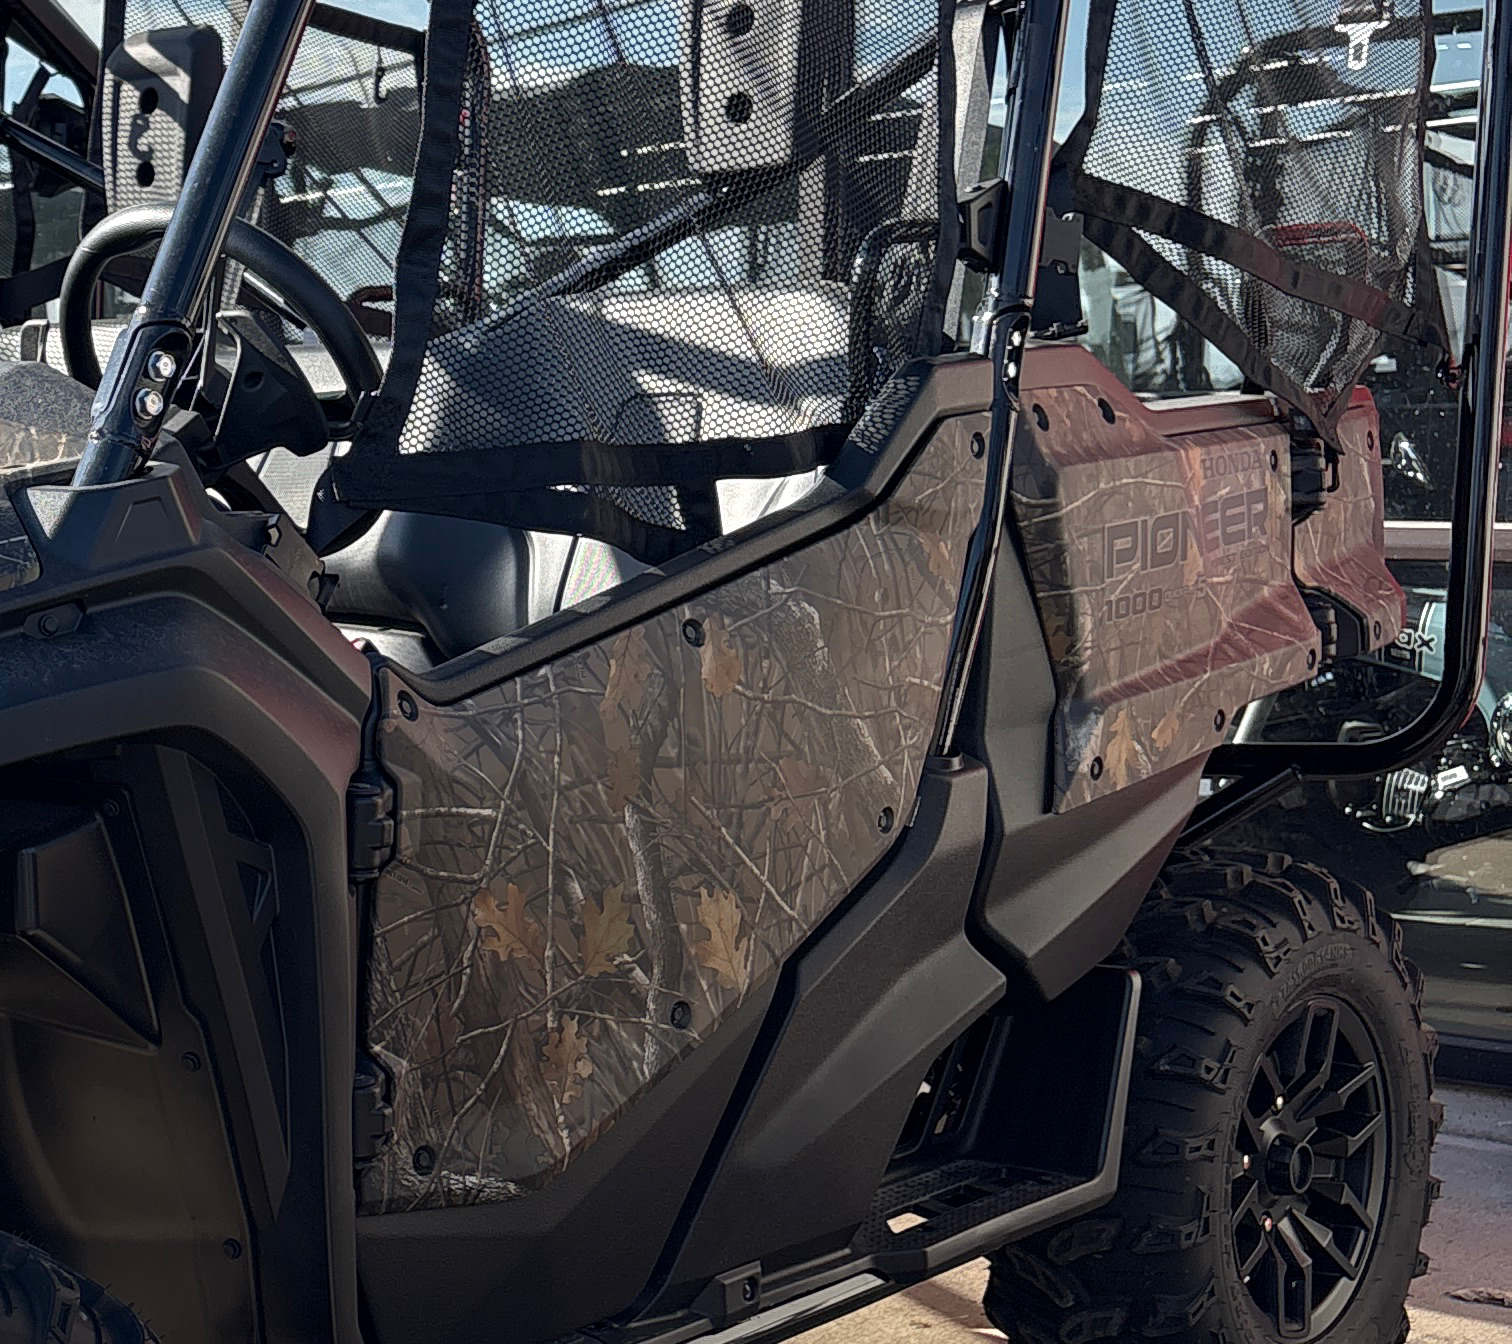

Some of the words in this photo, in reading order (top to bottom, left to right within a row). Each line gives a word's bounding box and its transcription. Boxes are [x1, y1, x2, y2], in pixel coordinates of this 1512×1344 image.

[1200, 450, 1264, 480] HONDA
[1103, 487, 1269, 583] PIONEER
[1103, 586, 1164, 624] 1000
